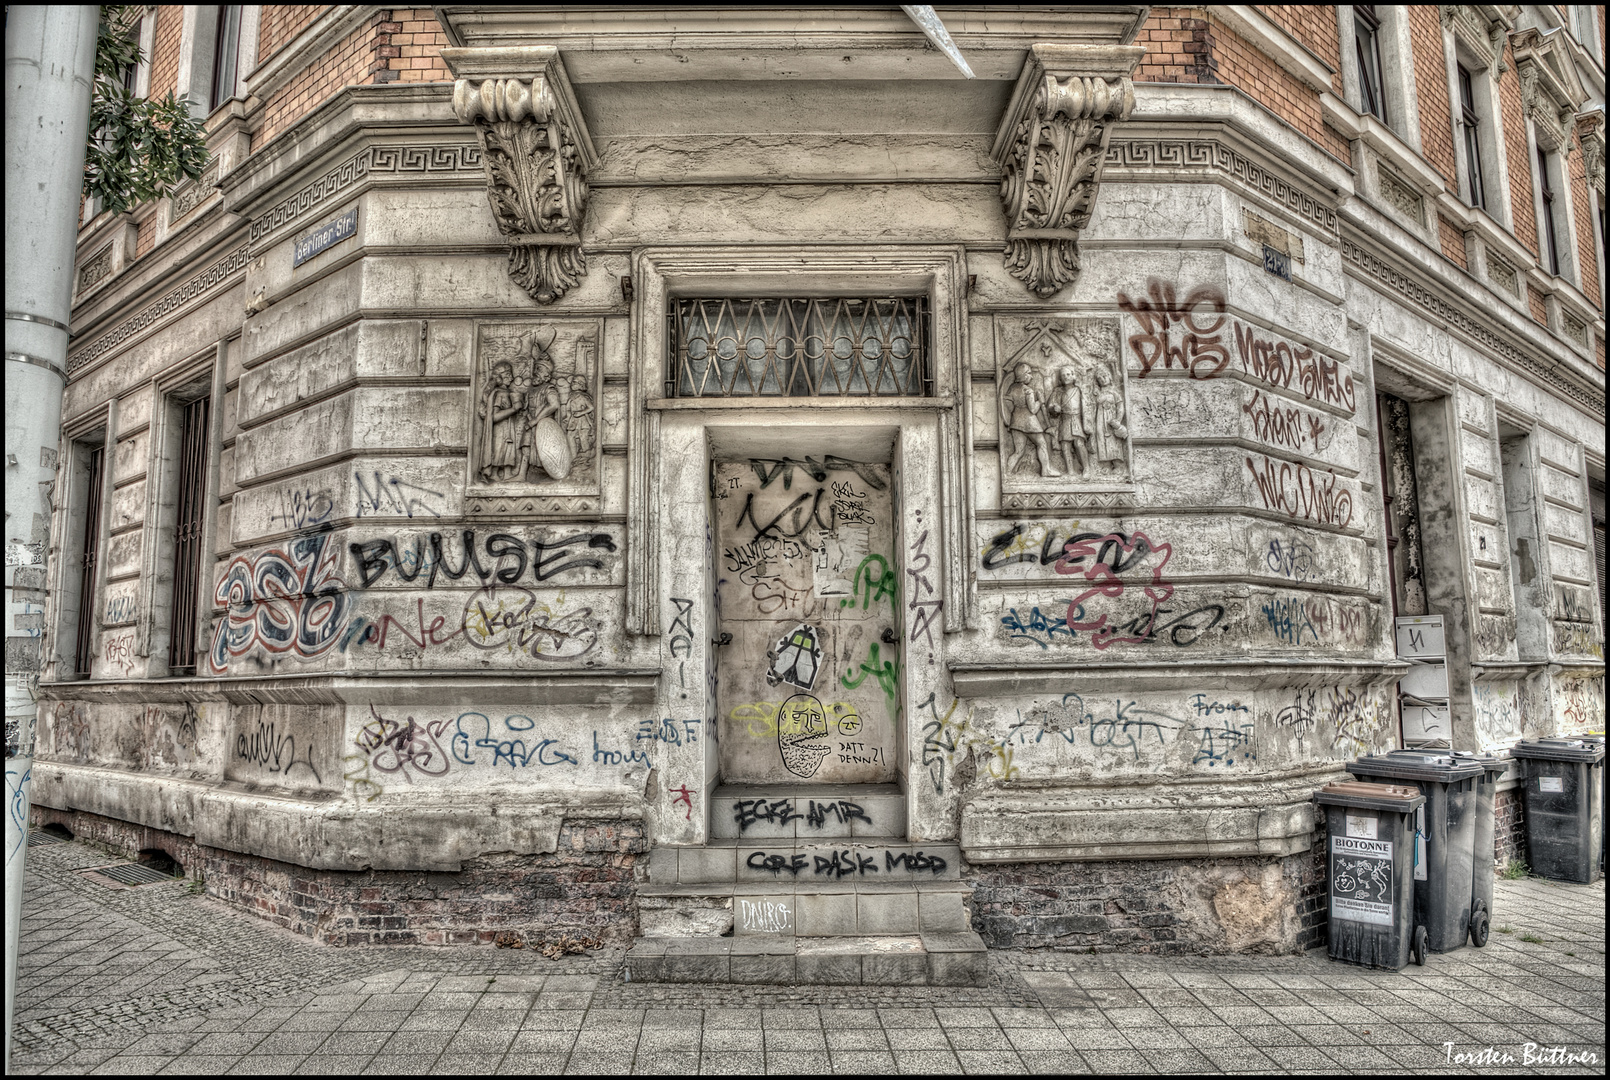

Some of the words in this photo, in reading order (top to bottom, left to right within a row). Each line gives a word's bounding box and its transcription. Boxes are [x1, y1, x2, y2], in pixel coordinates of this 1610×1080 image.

[297, 228, 334, 260] Berliner
[350, 530, 617, 588] BUMSE
[1335, 838, 1389, 852] BIOTONNE
